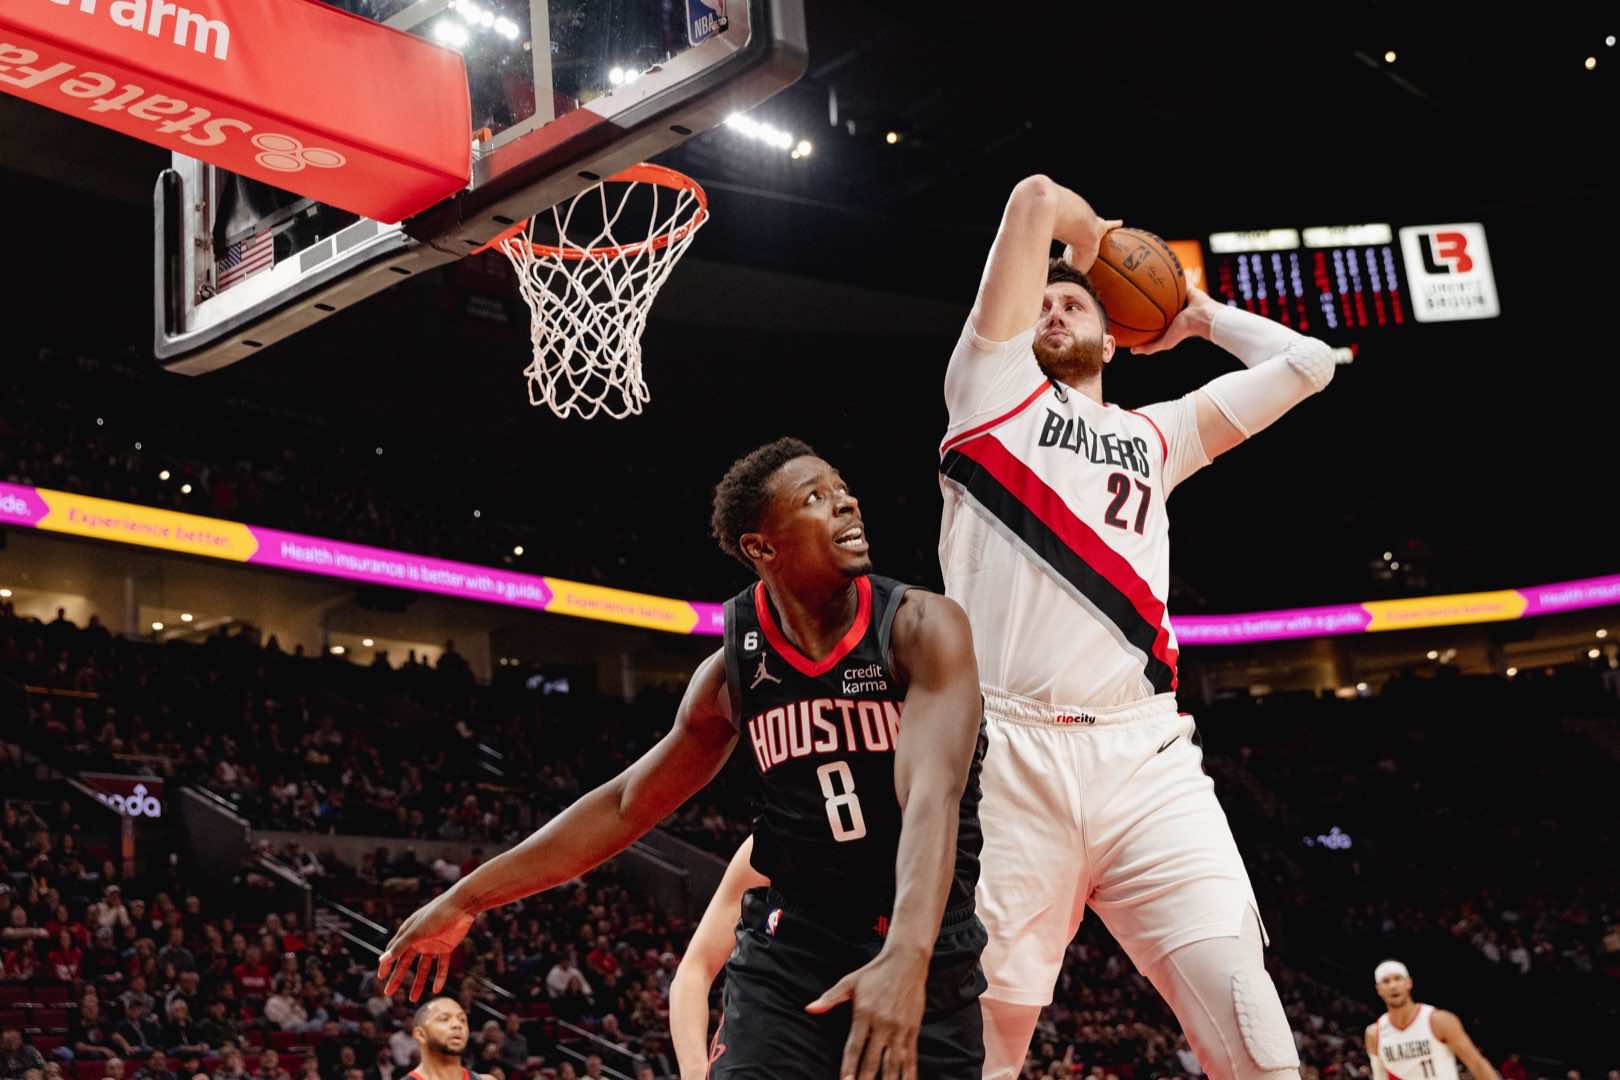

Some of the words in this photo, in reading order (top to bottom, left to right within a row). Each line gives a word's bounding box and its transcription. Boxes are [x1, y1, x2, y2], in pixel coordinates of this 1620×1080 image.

[80, 0, 230, 61] arm
[694, 12, 715, 39] NBA
[59, 72, 253, 146] State
[1038, 407, 1150, 479] BLAZERS
[1104, 472, 1152, 536] 27
[175, 526, 229, 546] better
[281, 541, 334, 566] Health
[335, 550, 405, 578] insurance
[420, 564, 464, 588] better
[465, 575, 495, 594] with
[743, 631, 758, 650] 6
[842, 680, 888, 695] karma
[843, 663, 883, 680] credit
[749, 698, 904, 774] HOUSTON
[96, 783, 161, 818] oda
[816, 760, 867, 843] 8
[1383, 1039, 1432, 1063] BLAZERS
[1420, 1058, 1436, 1079] 11
